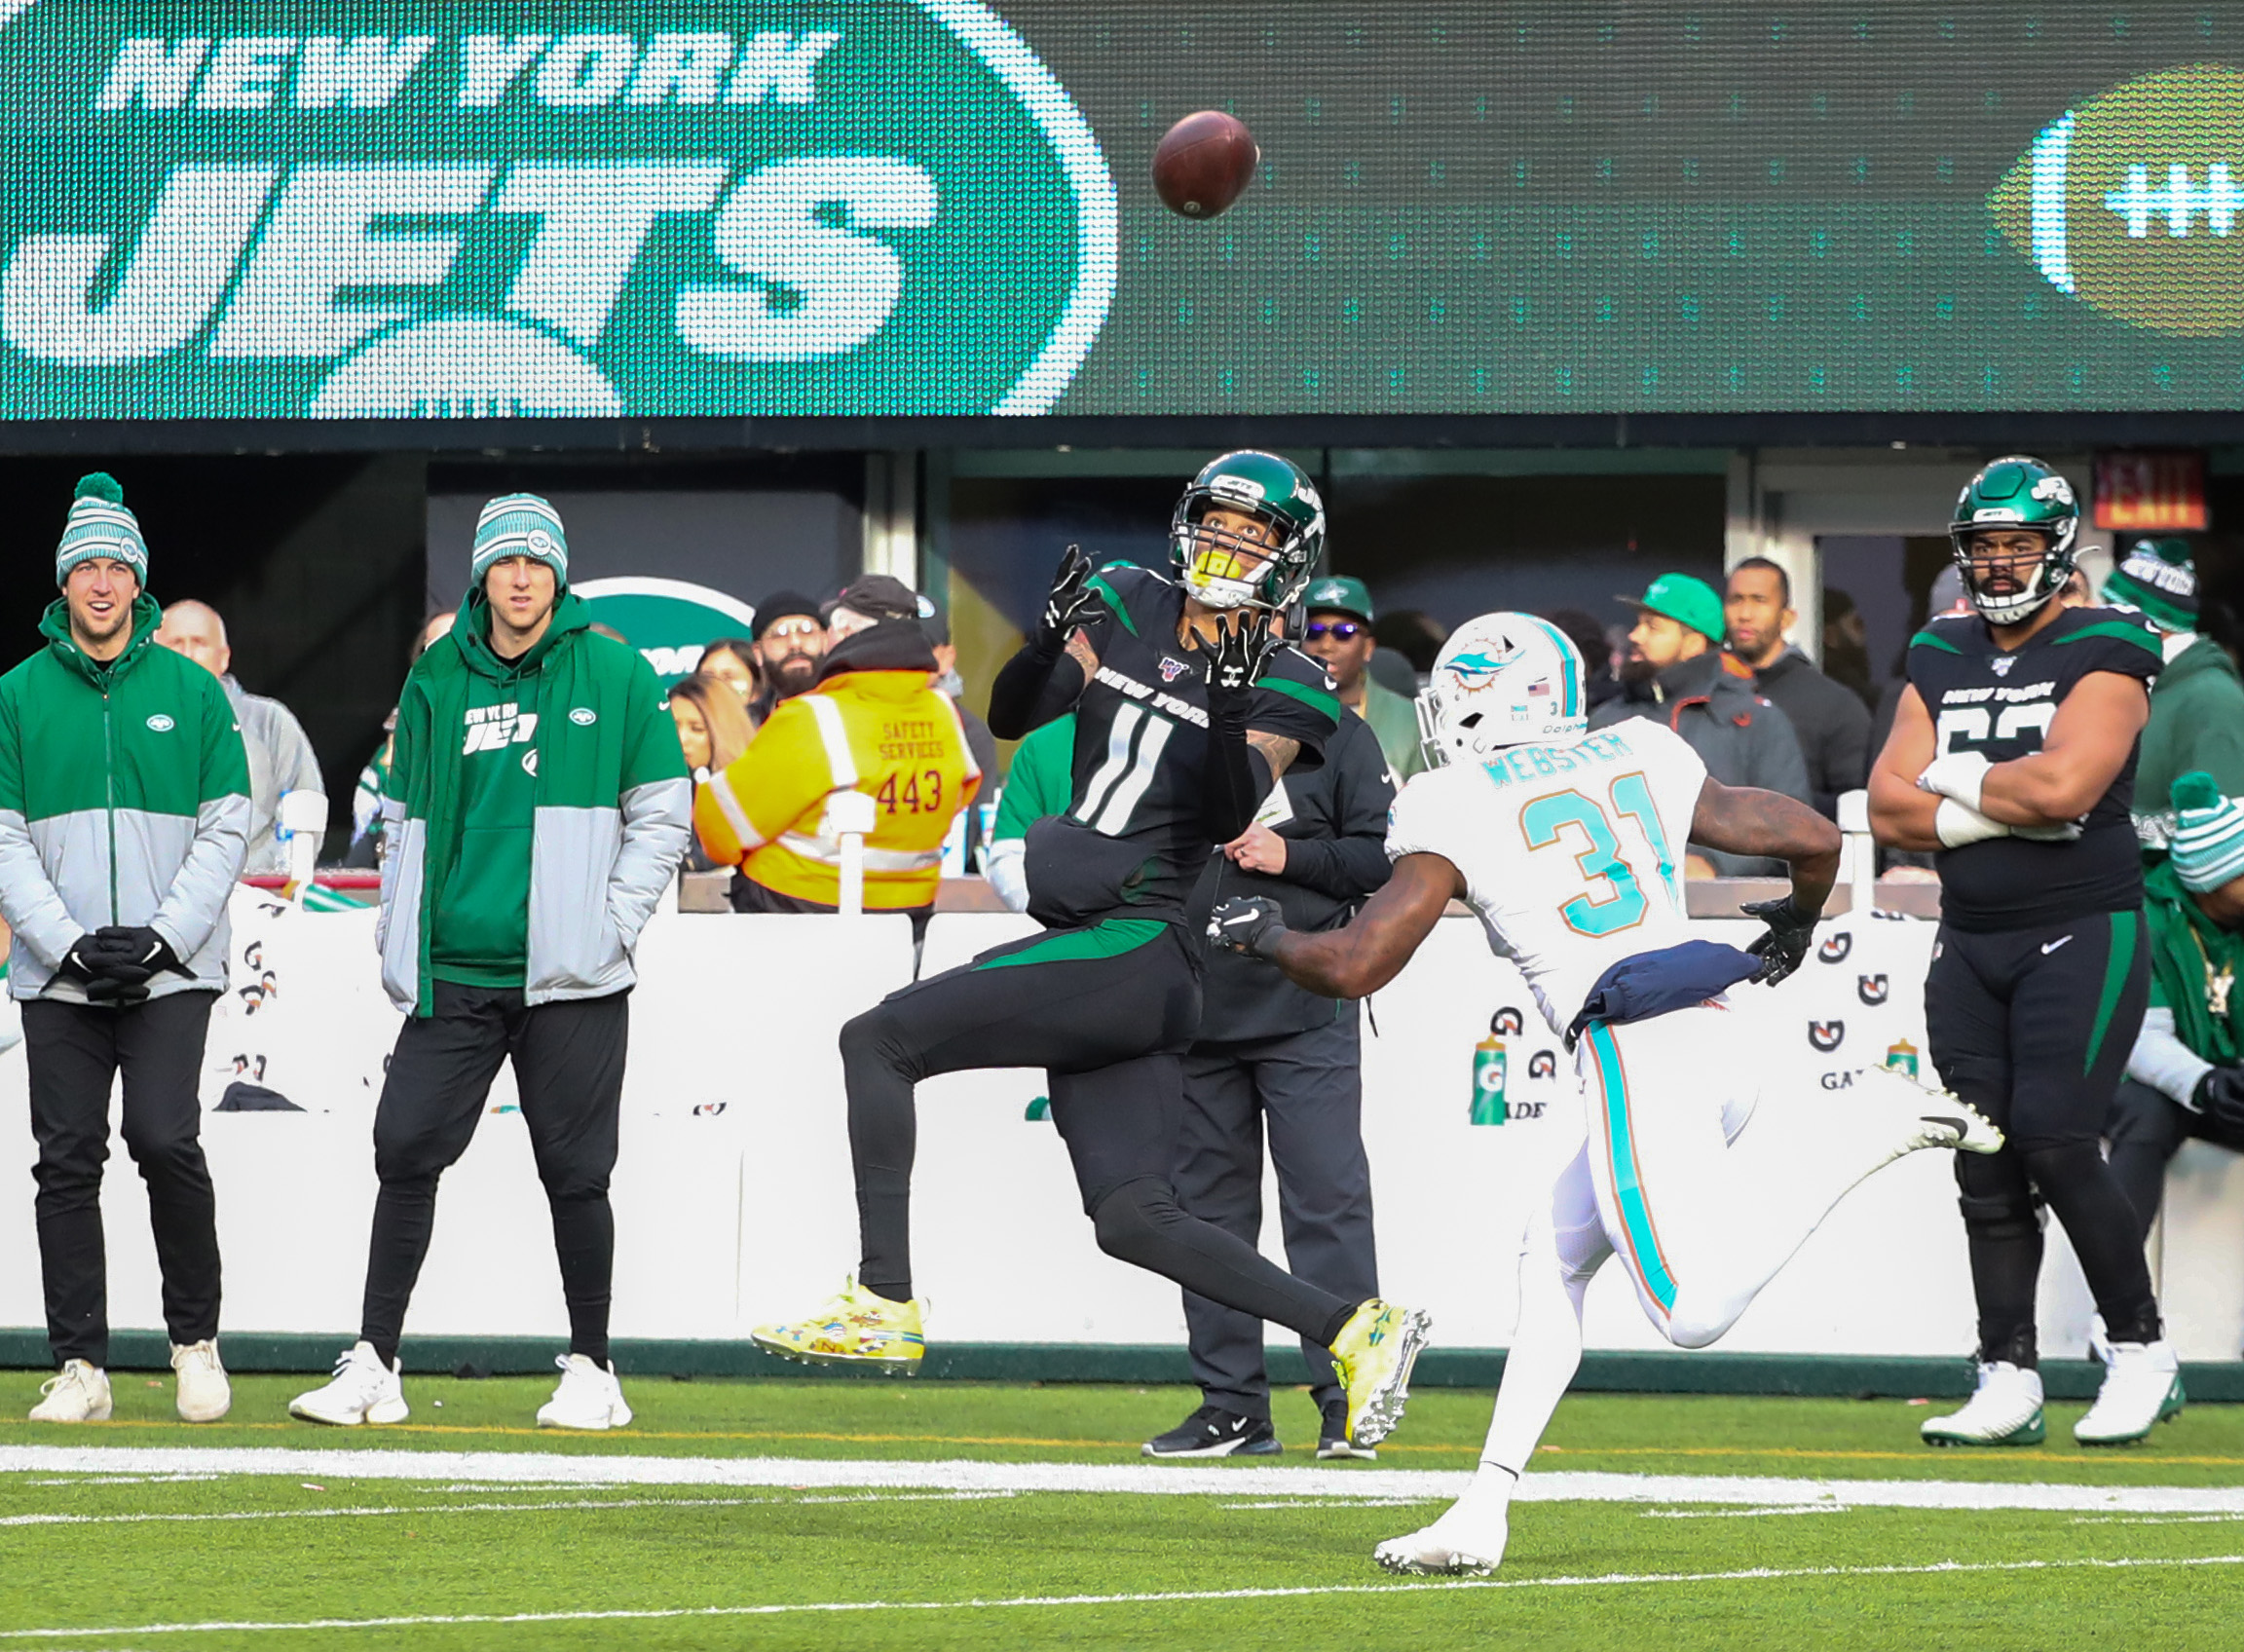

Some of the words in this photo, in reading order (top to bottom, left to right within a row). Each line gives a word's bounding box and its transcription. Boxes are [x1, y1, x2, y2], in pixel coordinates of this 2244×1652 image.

[95, 33, 436, 111] NEW
[458, 30, 840, 107] YORK
[4, 156, 940, 366] JETS
[464, 708, 486, 726] EW
[1094, 666, 1155, 699] NEW
[1151, 693, 1210, 730] YOR
[1942, 688, 1995, 704] NEW
[1994, 682, 2056, 703] YORK
[463, 713, 539, 756] JET
[879, 741, 945, 760] SERVICES
[883, 721, 934, 739] SAFETY
[1072, 698, 1178, 837] 11
[1480, 732, 1633, 789] WEBSTER
[878, 770, 942, 814] 443
[1518, 770, 1681, 939] 31
